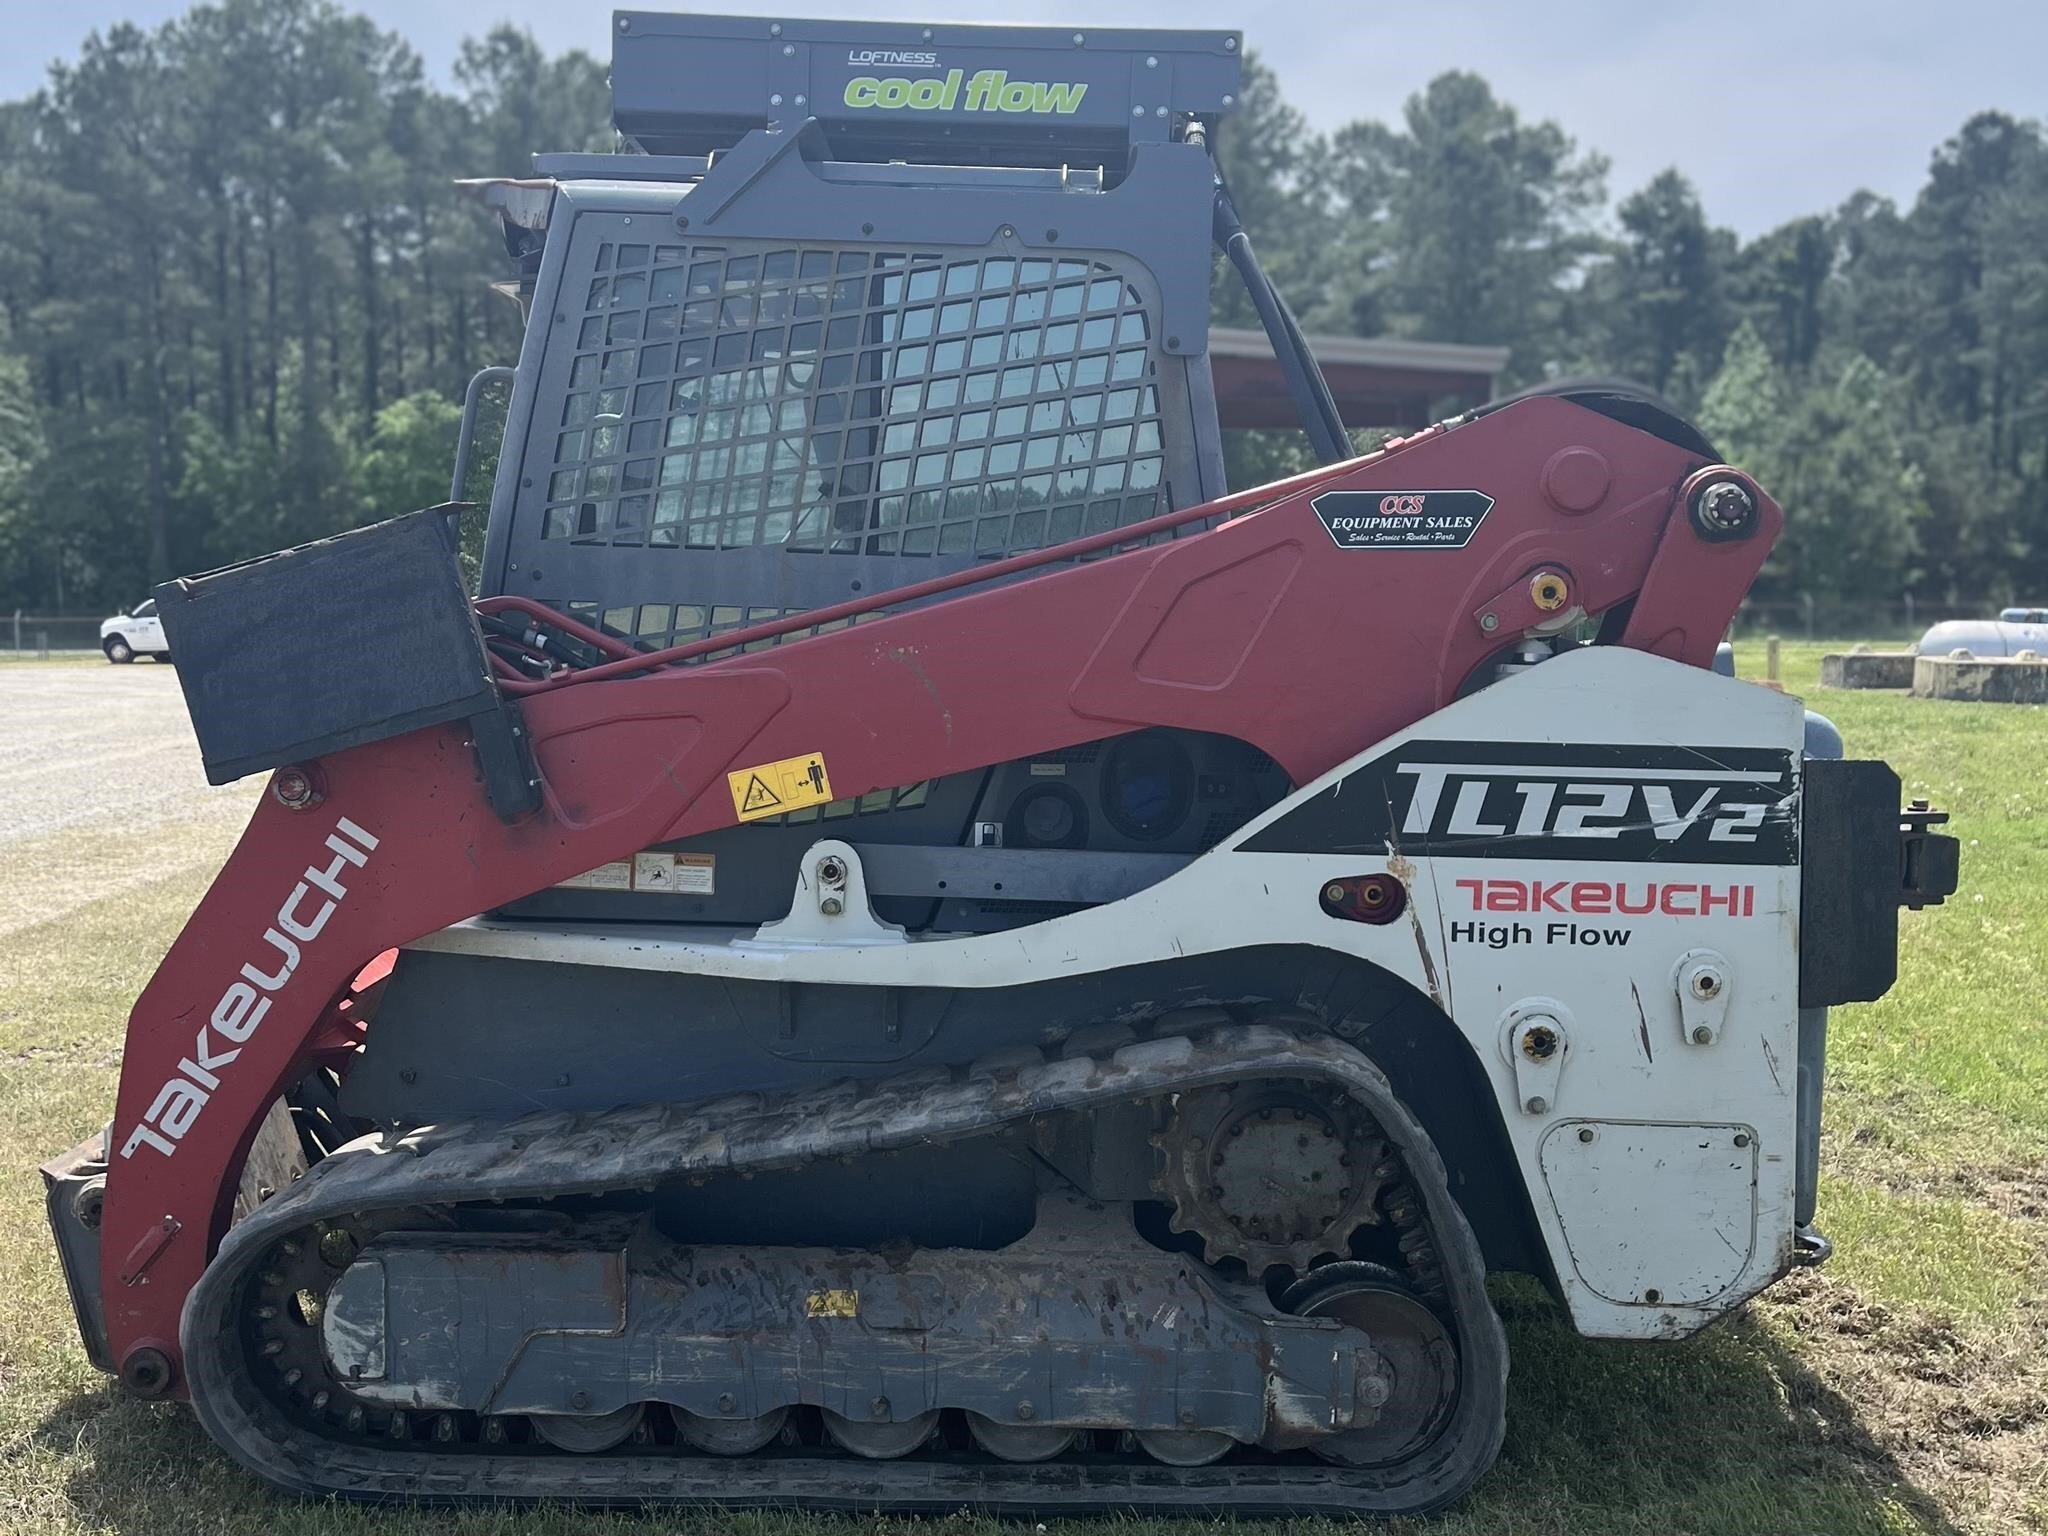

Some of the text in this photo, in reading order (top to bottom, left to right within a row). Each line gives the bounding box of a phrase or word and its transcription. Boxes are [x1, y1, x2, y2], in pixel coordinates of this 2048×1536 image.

[848, 50, 937, 67] LOFTNESS
[844, 68, 1088, 113] cool flow
[1379, 495, 1425, 515] CCS
[1331, 516, 1473, 530] EQUIPMENT SALES
[1348, 532, 1370, 542] Sales
[1405, 532, 1430, 541] Rental
[1434, 531, 1456, 541] Parts
[1450, 921, 1632, 949] High Flow
